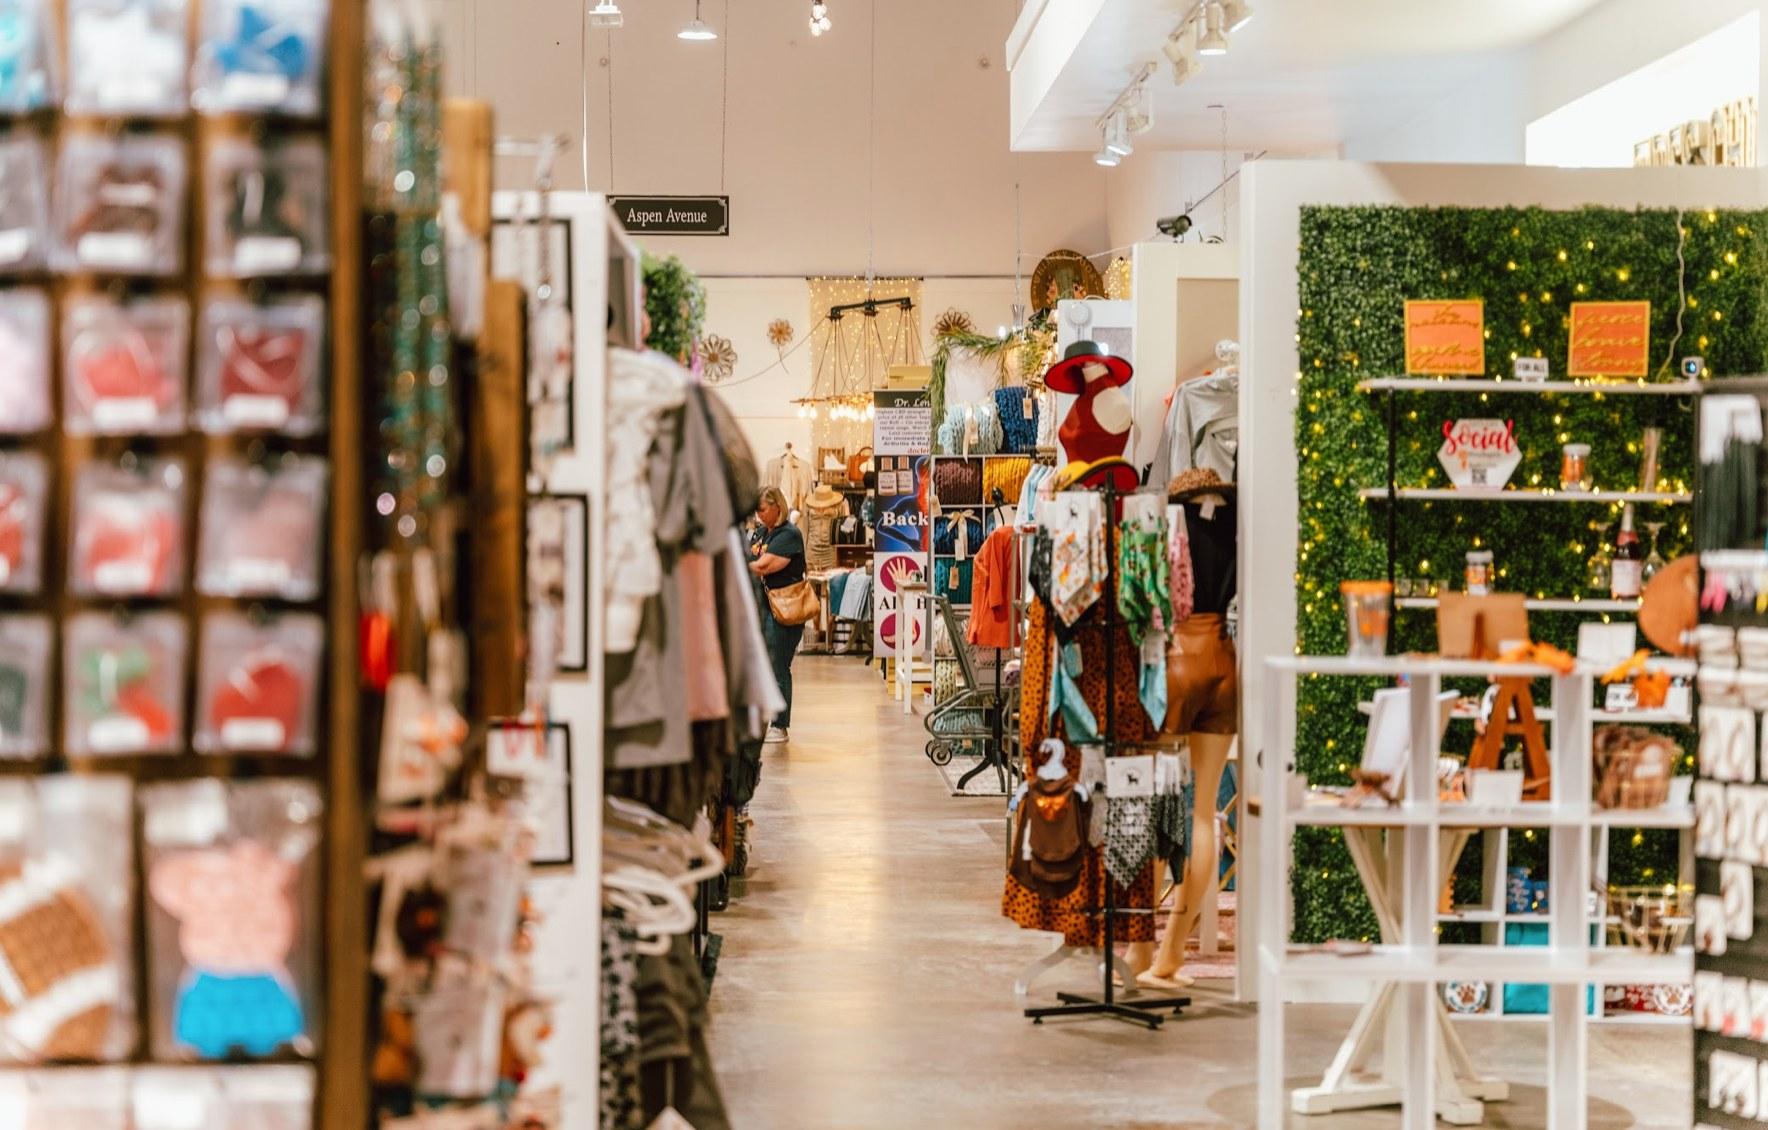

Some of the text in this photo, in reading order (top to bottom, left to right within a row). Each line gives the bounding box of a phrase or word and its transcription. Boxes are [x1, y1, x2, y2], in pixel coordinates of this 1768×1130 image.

[627, 207, 708, 227] Aspen Avenue
[894, 398, 910, 408] Dr.
[1442, 418, 1520, 456] Social
[881, 511, 929, 527] Back
